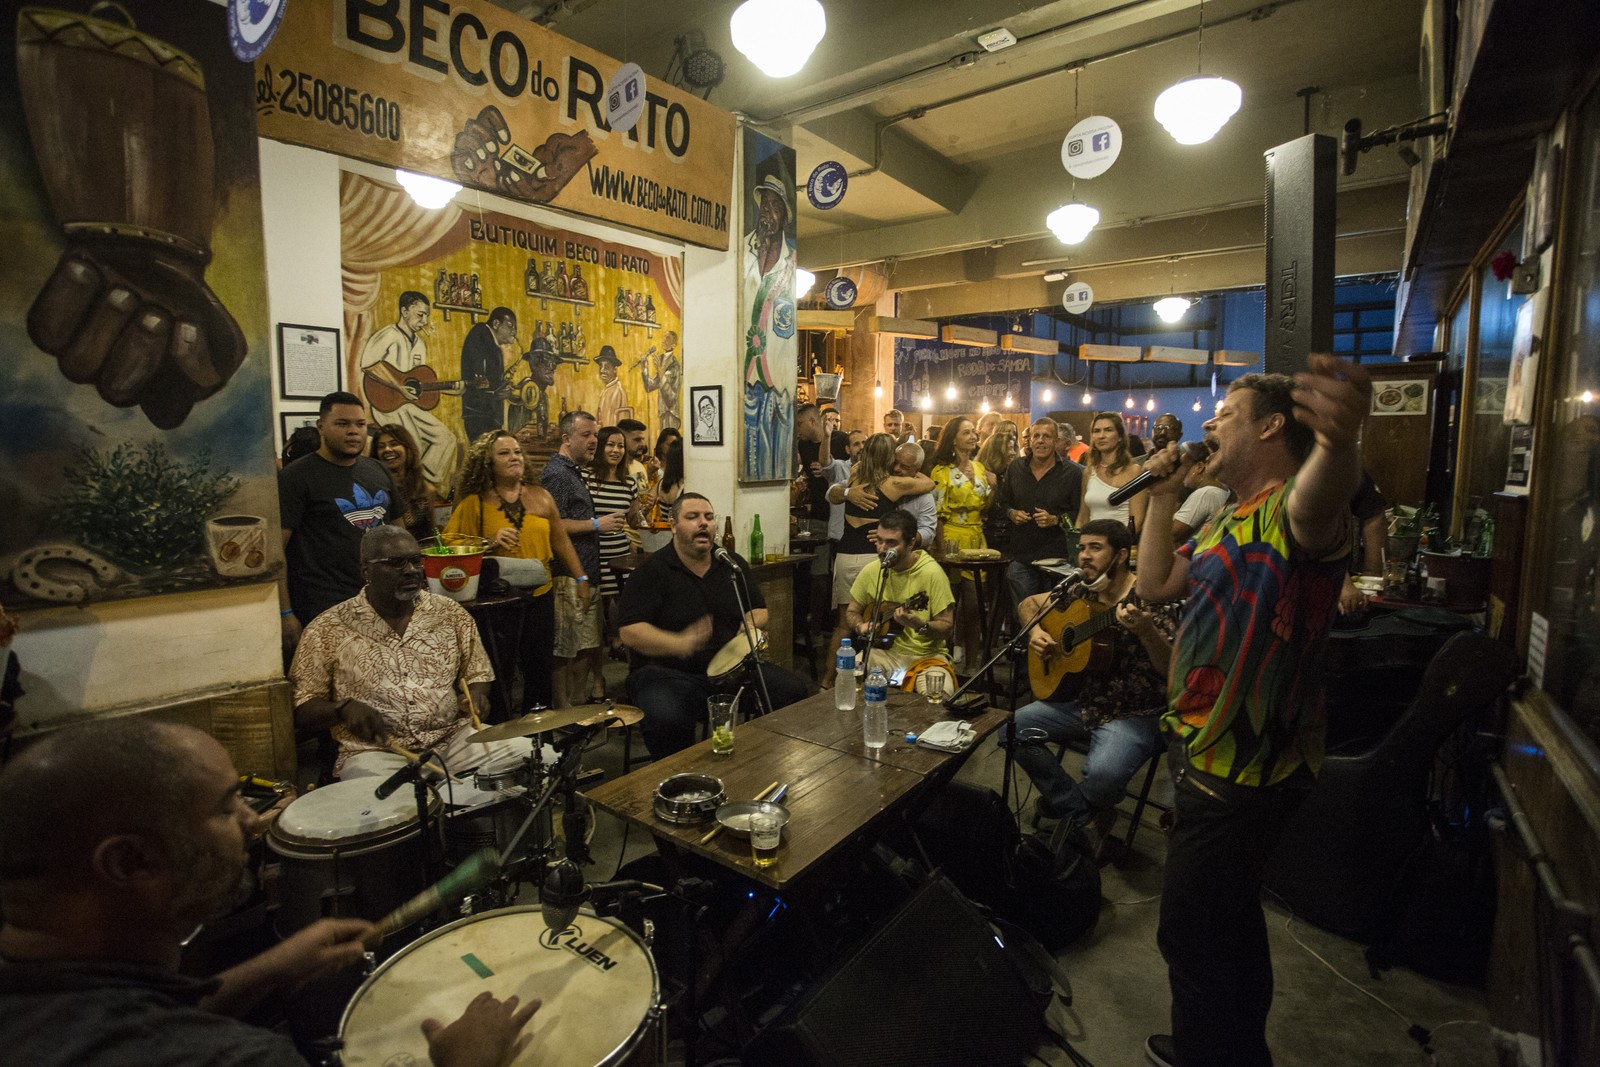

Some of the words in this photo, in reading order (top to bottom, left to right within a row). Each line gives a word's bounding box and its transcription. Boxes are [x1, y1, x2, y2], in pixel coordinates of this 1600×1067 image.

[257, 63, 280, 103] el.
[346, 0, 528, 97] BECO
[531, 60, 559, 101] do
[567, 55, 690, 156] RTO
[470, 219, 557, 256] BUTIQUIM
[564, 241, 599, 265] BECO
[604, 250, 617, 269] DO
[622, 253, 650, 275] RATO
[564, 937, 618, 971] LUEN
